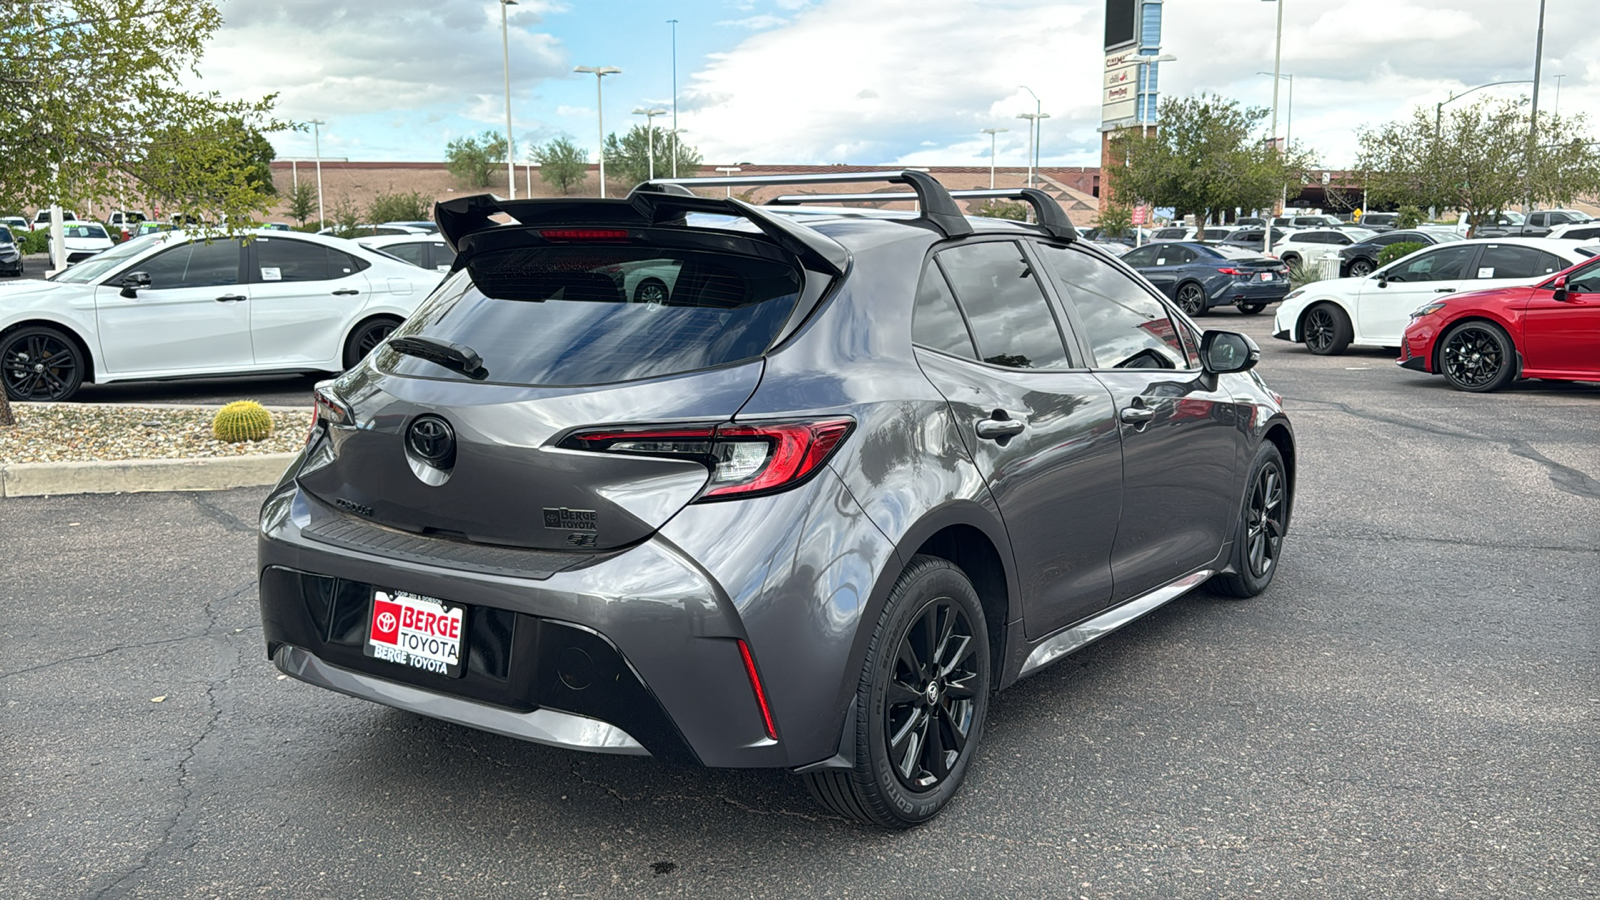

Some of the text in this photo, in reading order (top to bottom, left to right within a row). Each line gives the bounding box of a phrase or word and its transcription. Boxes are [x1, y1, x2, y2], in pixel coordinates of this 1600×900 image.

[561, 520, 597, 530] TOYOTA
[402, 606, 460, 639] BERGE
[374, 644, 448, 675] BERGE TOYOTA
[401, 631, 459, 660] TOYOTA
